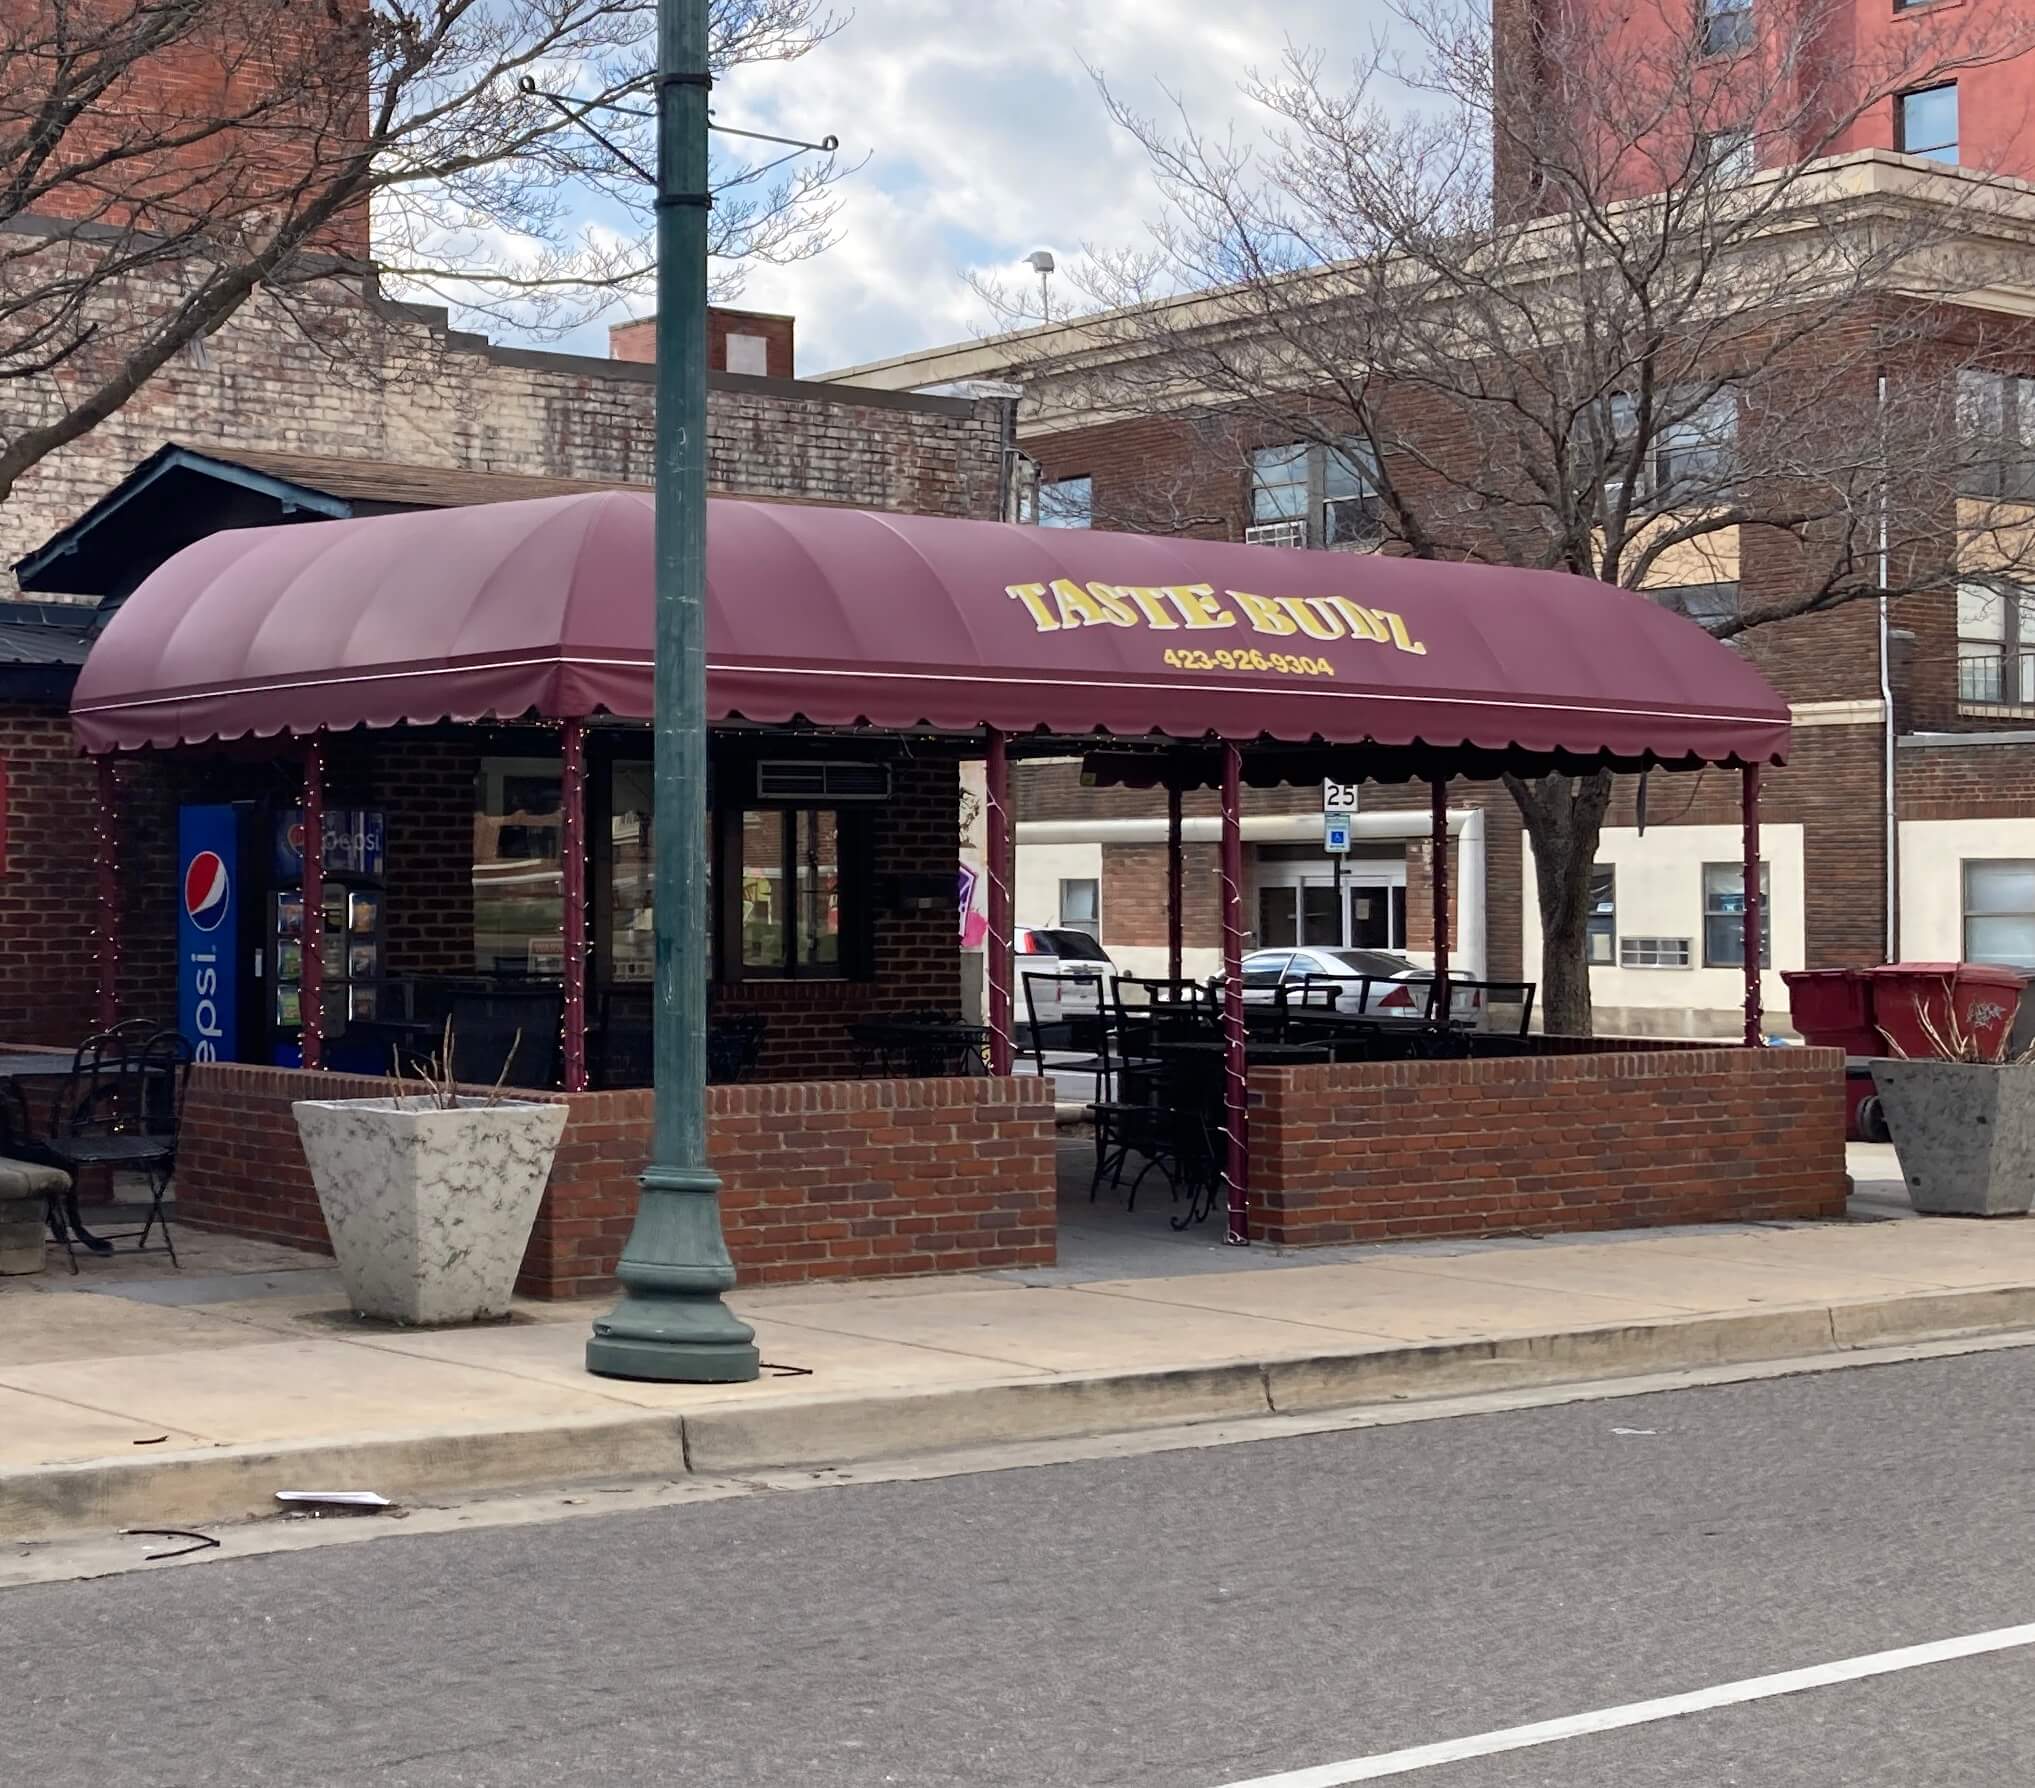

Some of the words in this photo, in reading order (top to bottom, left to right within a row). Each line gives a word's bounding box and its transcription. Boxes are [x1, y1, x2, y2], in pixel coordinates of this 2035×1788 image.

[1005, 579, 1237, 633] TASTE
[1225, 590, 1427, 655] BUDZ
[1163, 649, 1335, 676] 423-926-9304
[1328, 785, 1354, 805] 25
[191, 953, 223, 1063] epsi
